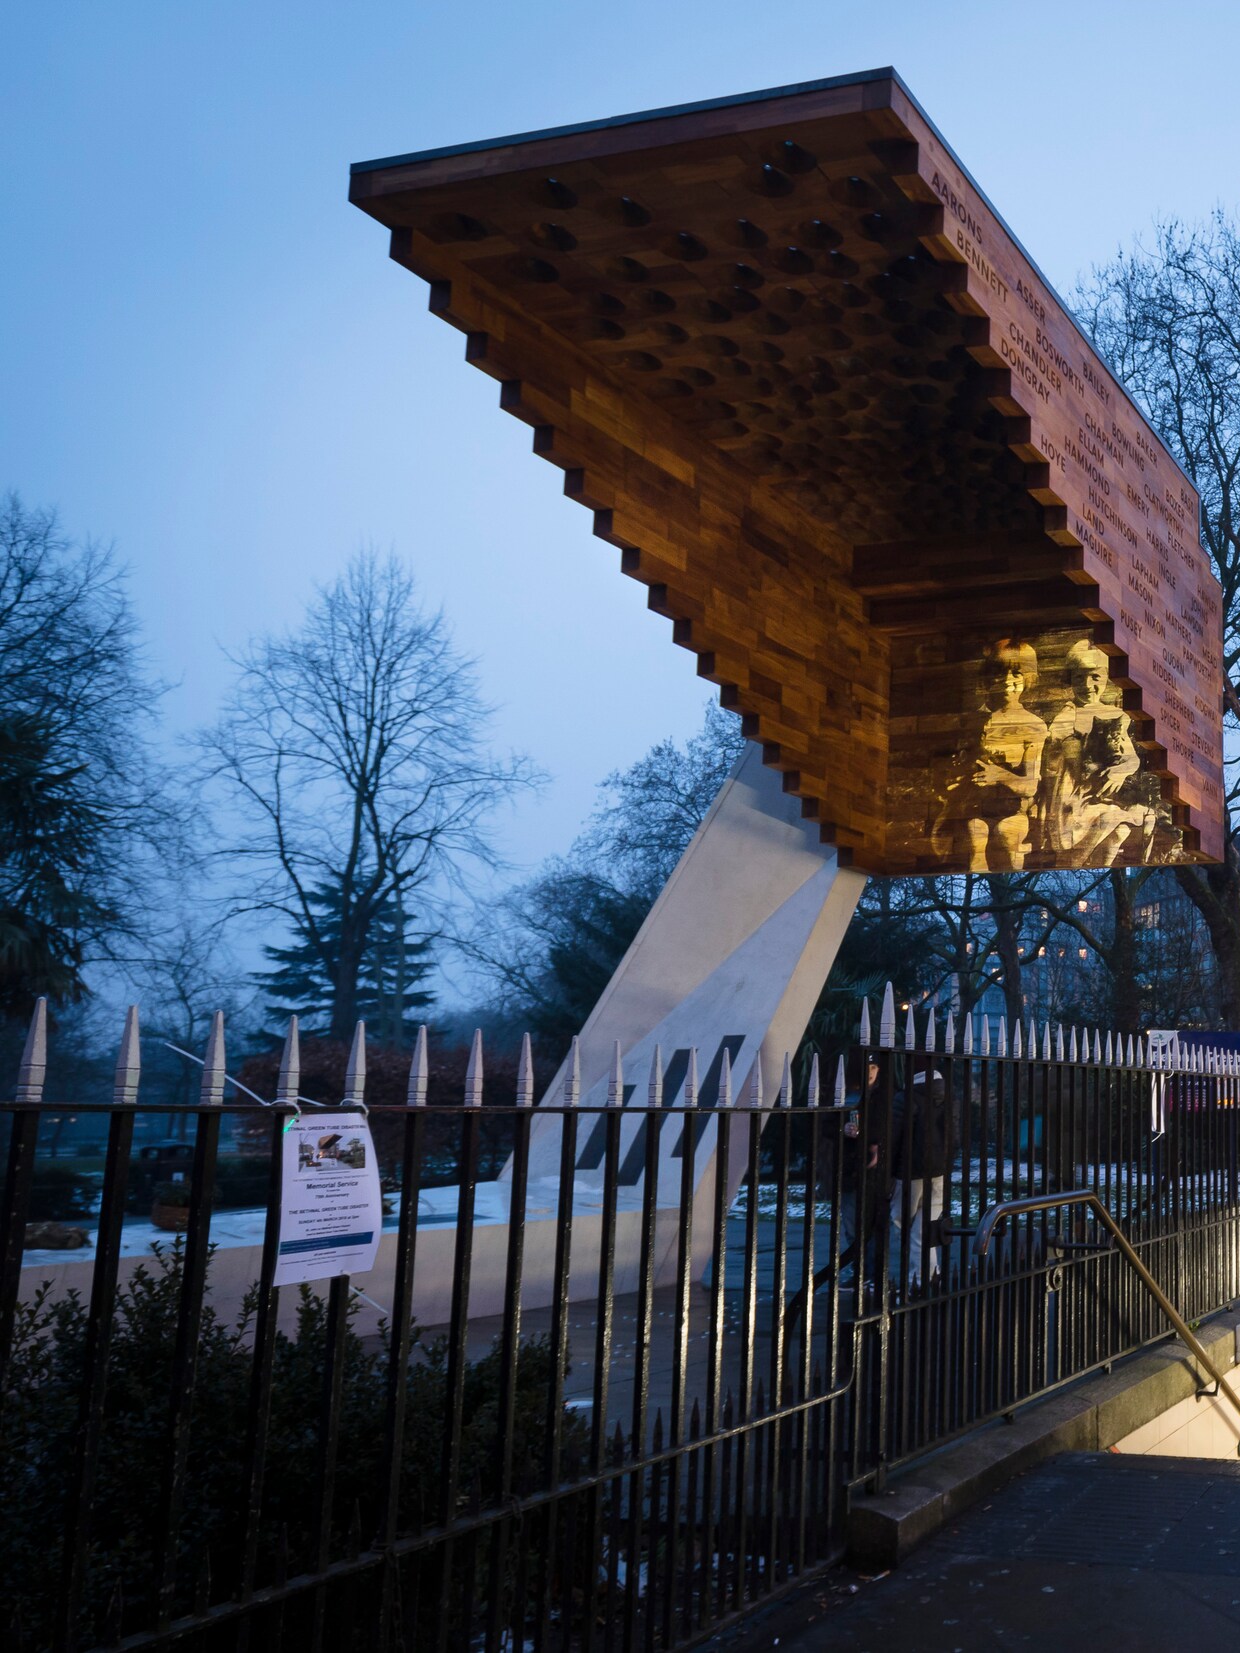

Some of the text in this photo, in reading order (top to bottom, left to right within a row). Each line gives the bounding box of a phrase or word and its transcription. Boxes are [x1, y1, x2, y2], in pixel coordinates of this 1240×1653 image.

[931, 171, 982, 244] AARONS
[956, 229, 1008, 303] BENNETT
[1016, 278, 1046, 326] ASSER
[1001, 337, 1051, 404] DONGRAY
[1009, 322, 1062, 396] CHANDLER
[1035, 327, 1085, 398] BOSWORTH
[1082, 362, 1110, 405] BAILEY
[1040, 433, 1067, 474] HOYE
[1078, 427, 1105, 468] ELLAM
[1085, 412, 1125, 469] CHAPMAN
[1111, 421, 1145, 472] BOWLING
[1136, 431, 1158, 469] BAKER
[1064, 434, 1110, 496] HAMMOND
[1082, 502, 1105, 536] LAND
[1088, 484, 1138, 549] HUTCHINSON
[1126, 483, 1150, 519] EMERY
[1075, 519, 1113, 569] MAGUIRE
[1146, 526, 1169, 562] HARRIS
[1127, 571, 1154, 609] MASON
[1131, 553, 1160, 593] LAPHAM
[1120, 608, 1143, 641] PUSEY
[1144, 607, 1167, 640] NIXON
[1152, 659, 1178, 692] RIDDELL
